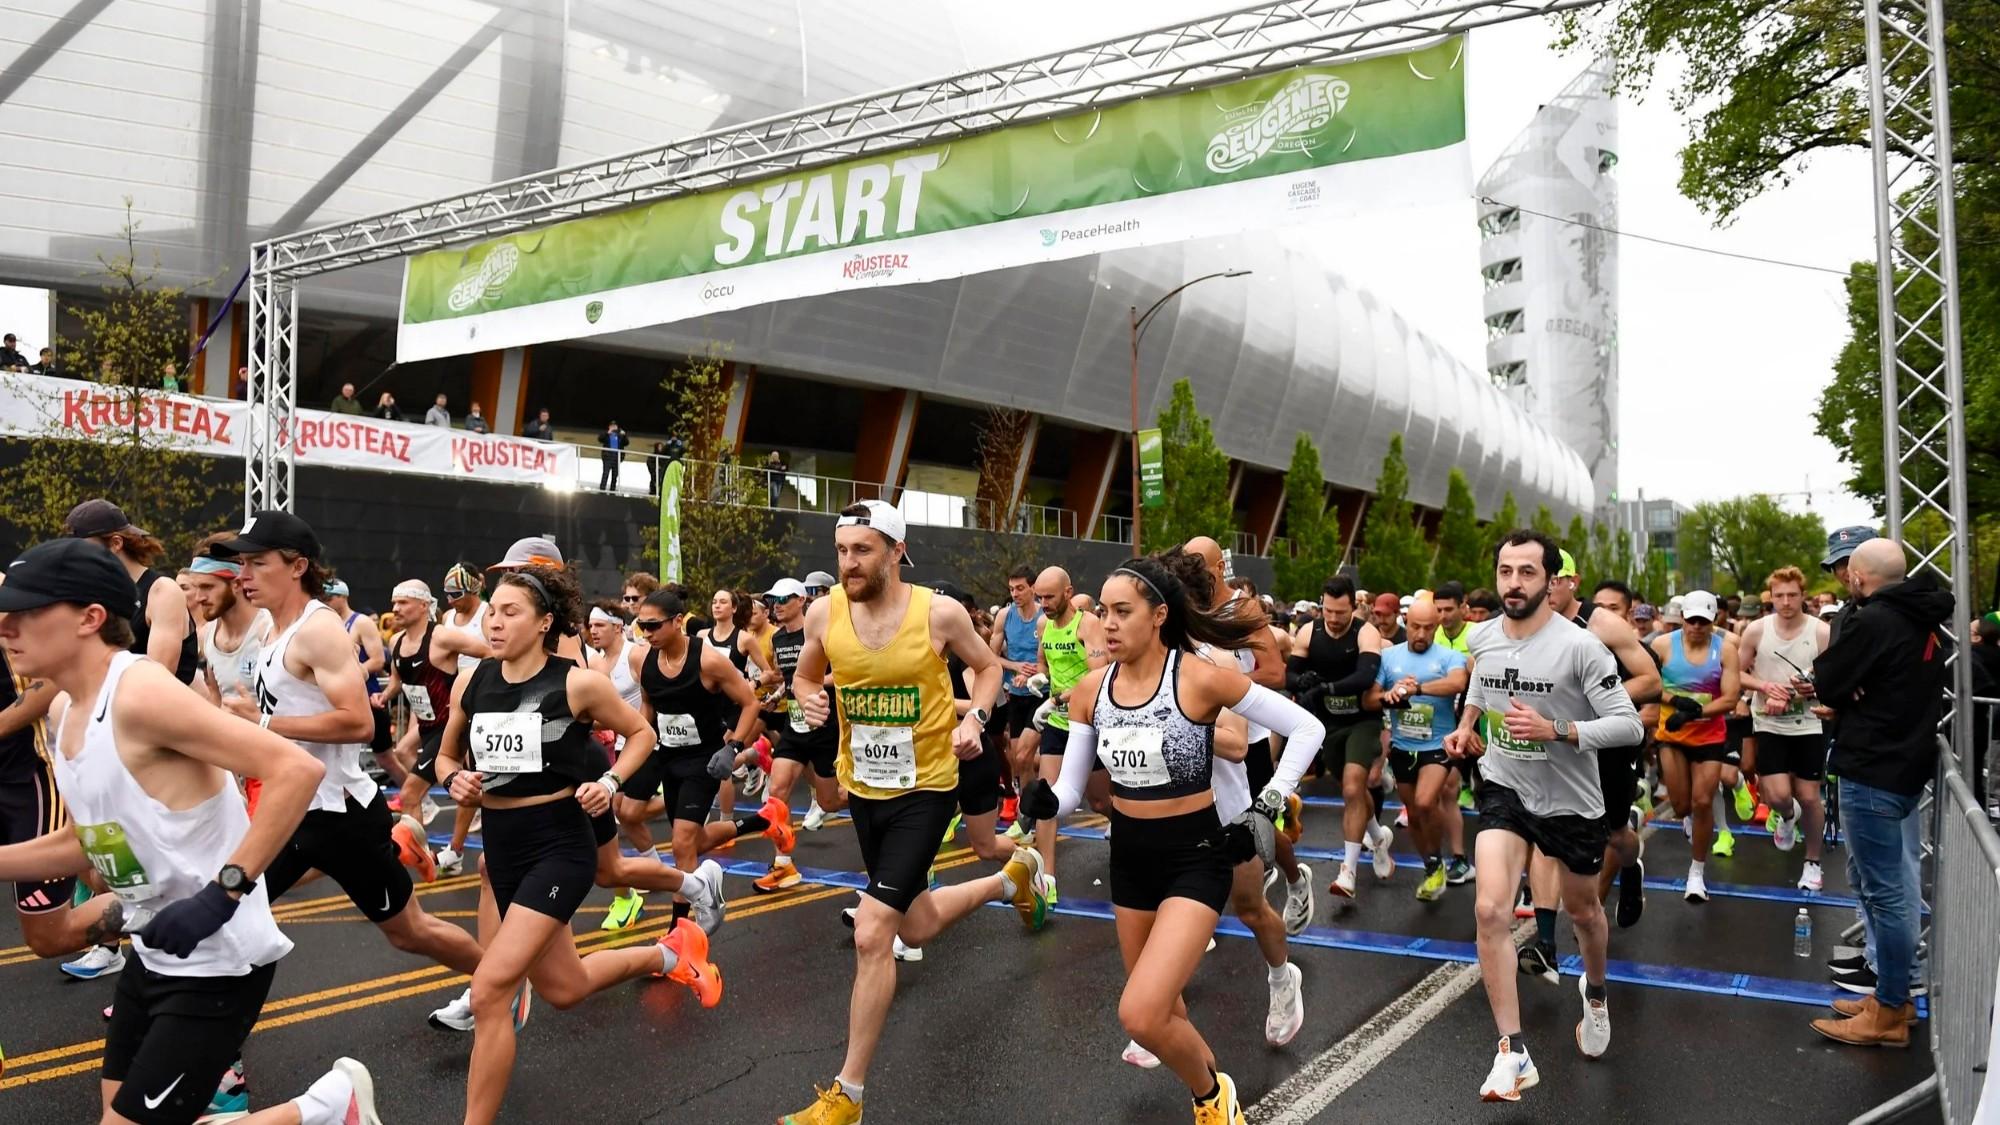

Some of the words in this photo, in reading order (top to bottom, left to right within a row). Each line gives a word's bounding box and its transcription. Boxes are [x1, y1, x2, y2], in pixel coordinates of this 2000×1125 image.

[1277, 138, 1316, 149] OREGON
[1292, 180, 1316, 190] EUGENE
[1300, 194, 1320, 202] COAST
[714, 153, 940, 265] START
[1061, 219, 1140, 241] PeaceHealth
[843, 254, 909, 278] KRUSTEAZ
[704, 284, 735, 299] OCCU
[1545, 318, 1600, 344] OREGON
[63, 389, 232, 445] KRUSTEAZ
[279, 415, 412, 464] KRUSTEAZ
[452, 437, 558, 475] KRUSTEAZ
[1055, 642, 1076, 650] COAST
[844, 692, 916, 718] OREGON
[1403, 711, 1425, 724] 2795
[666, 725, 688, 736] 6286
[1498, 727, 1530, 746] 27
[486, 734, 524, 752] 5703
[864, 743, 899, 759] 6074
[1111, 750, 1148, 768] 5702
